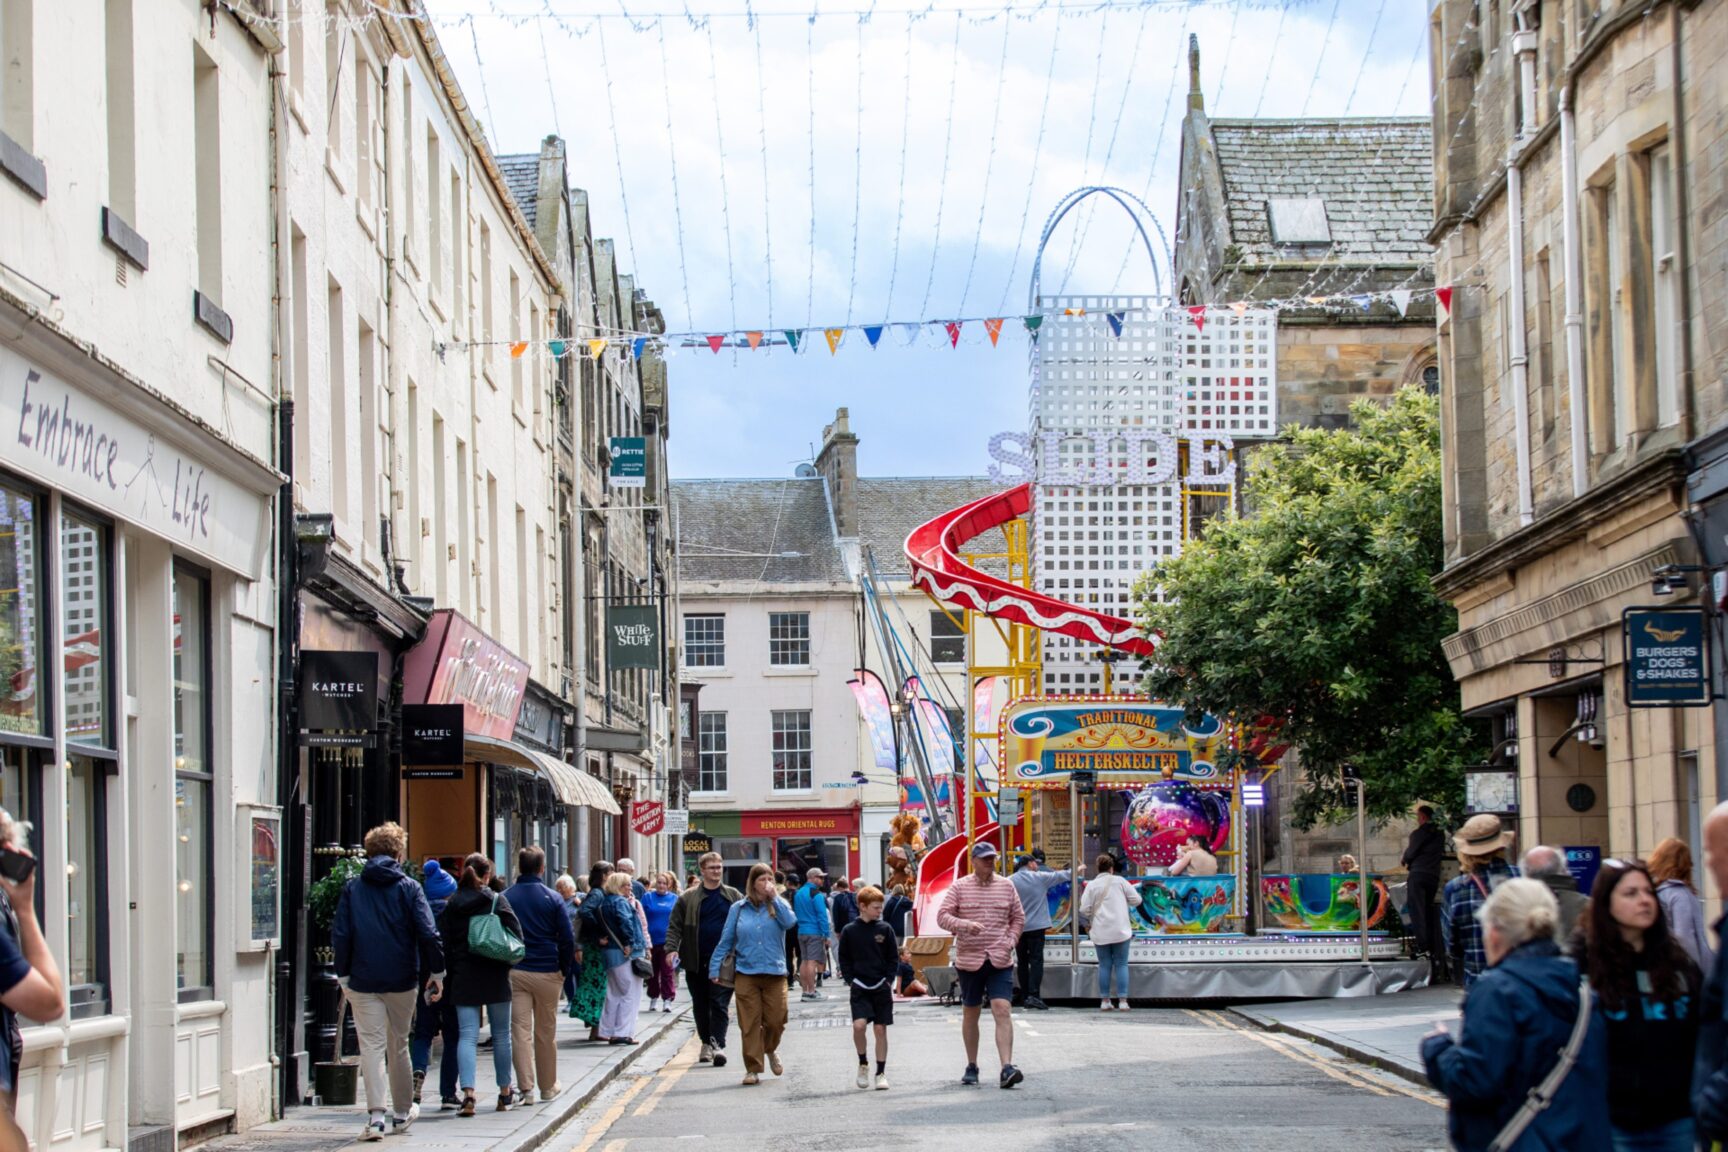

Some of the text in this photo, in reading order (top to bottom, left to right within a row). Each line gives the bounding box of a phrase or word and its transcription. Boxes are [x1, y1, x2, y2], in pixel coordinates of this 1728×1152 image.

[18, 367, 209, 540] Embrace Life
[988, 431, 1236, 485] SLIDE
[1636, 647, 1698, 657] BURGERS
[1648, 658, 1686, 668] DOGS
[312, 682, 364, 692] KARTEL
[1076, 710, 1158, 729] TRADITIONAL
[631, 804, 661, 828] SALVATION
[637, 803, 650, 815] THE
[642, 815, 660, 832] ARMY
[761, 820, 835, 829] RENTON ORIENTAL RUGS
